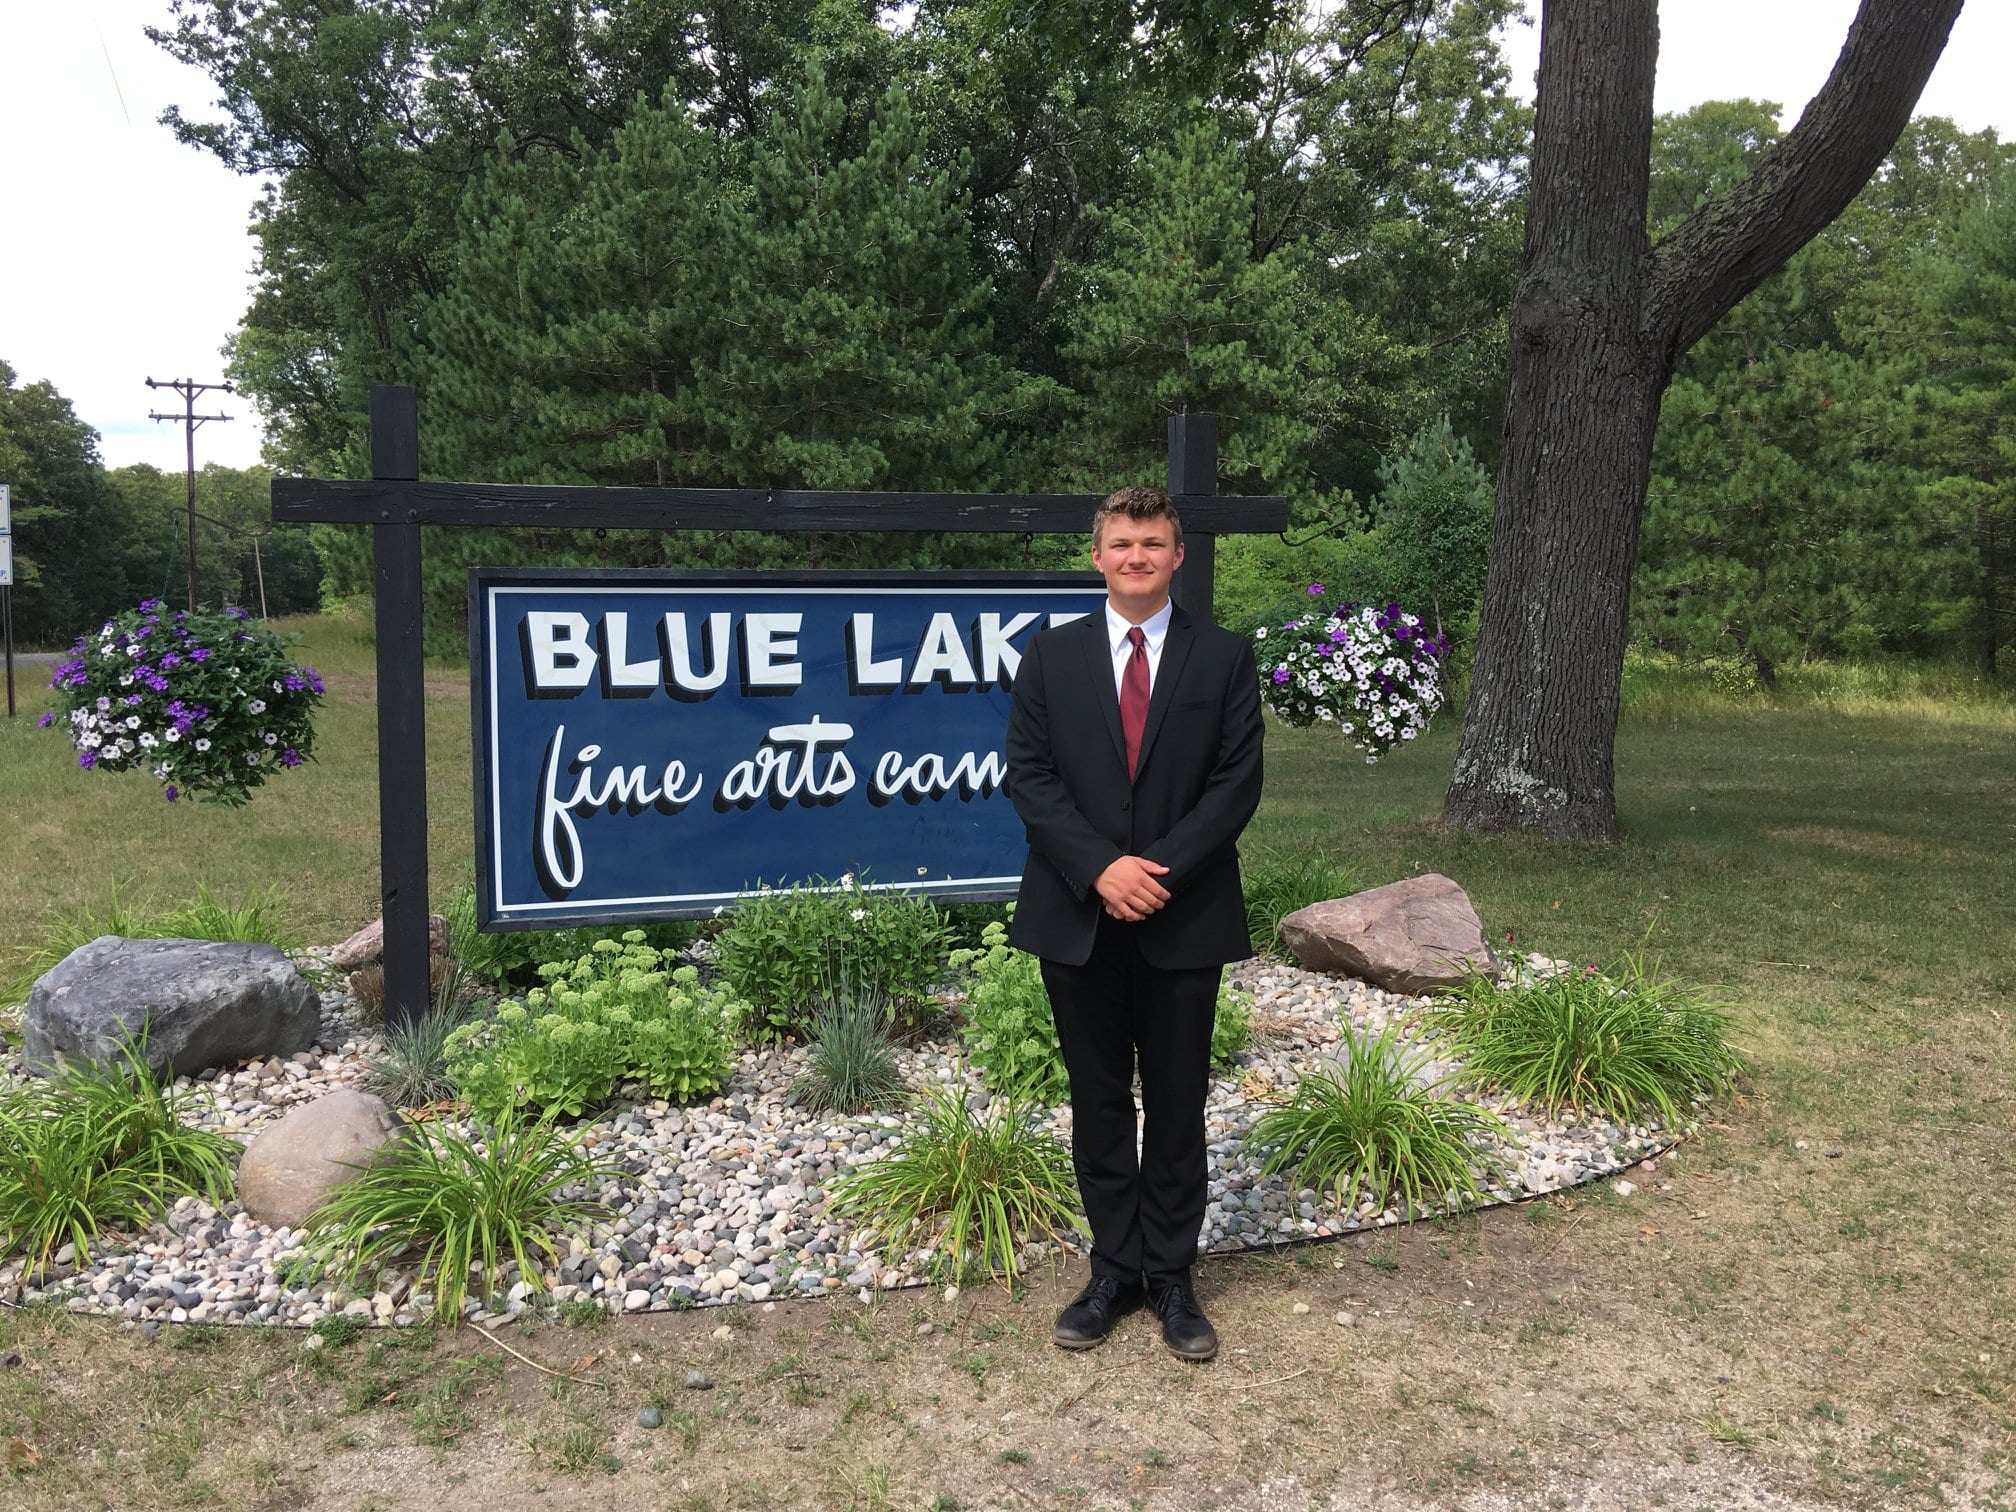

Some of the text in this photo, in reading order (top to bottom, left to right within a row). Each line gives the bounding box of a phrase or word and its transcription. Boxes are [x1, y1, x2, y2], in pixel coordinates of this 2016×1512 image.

[524, 610, 1092, 694] BLUE LAK
[540, 713, 1009, 889] fine arts cam
